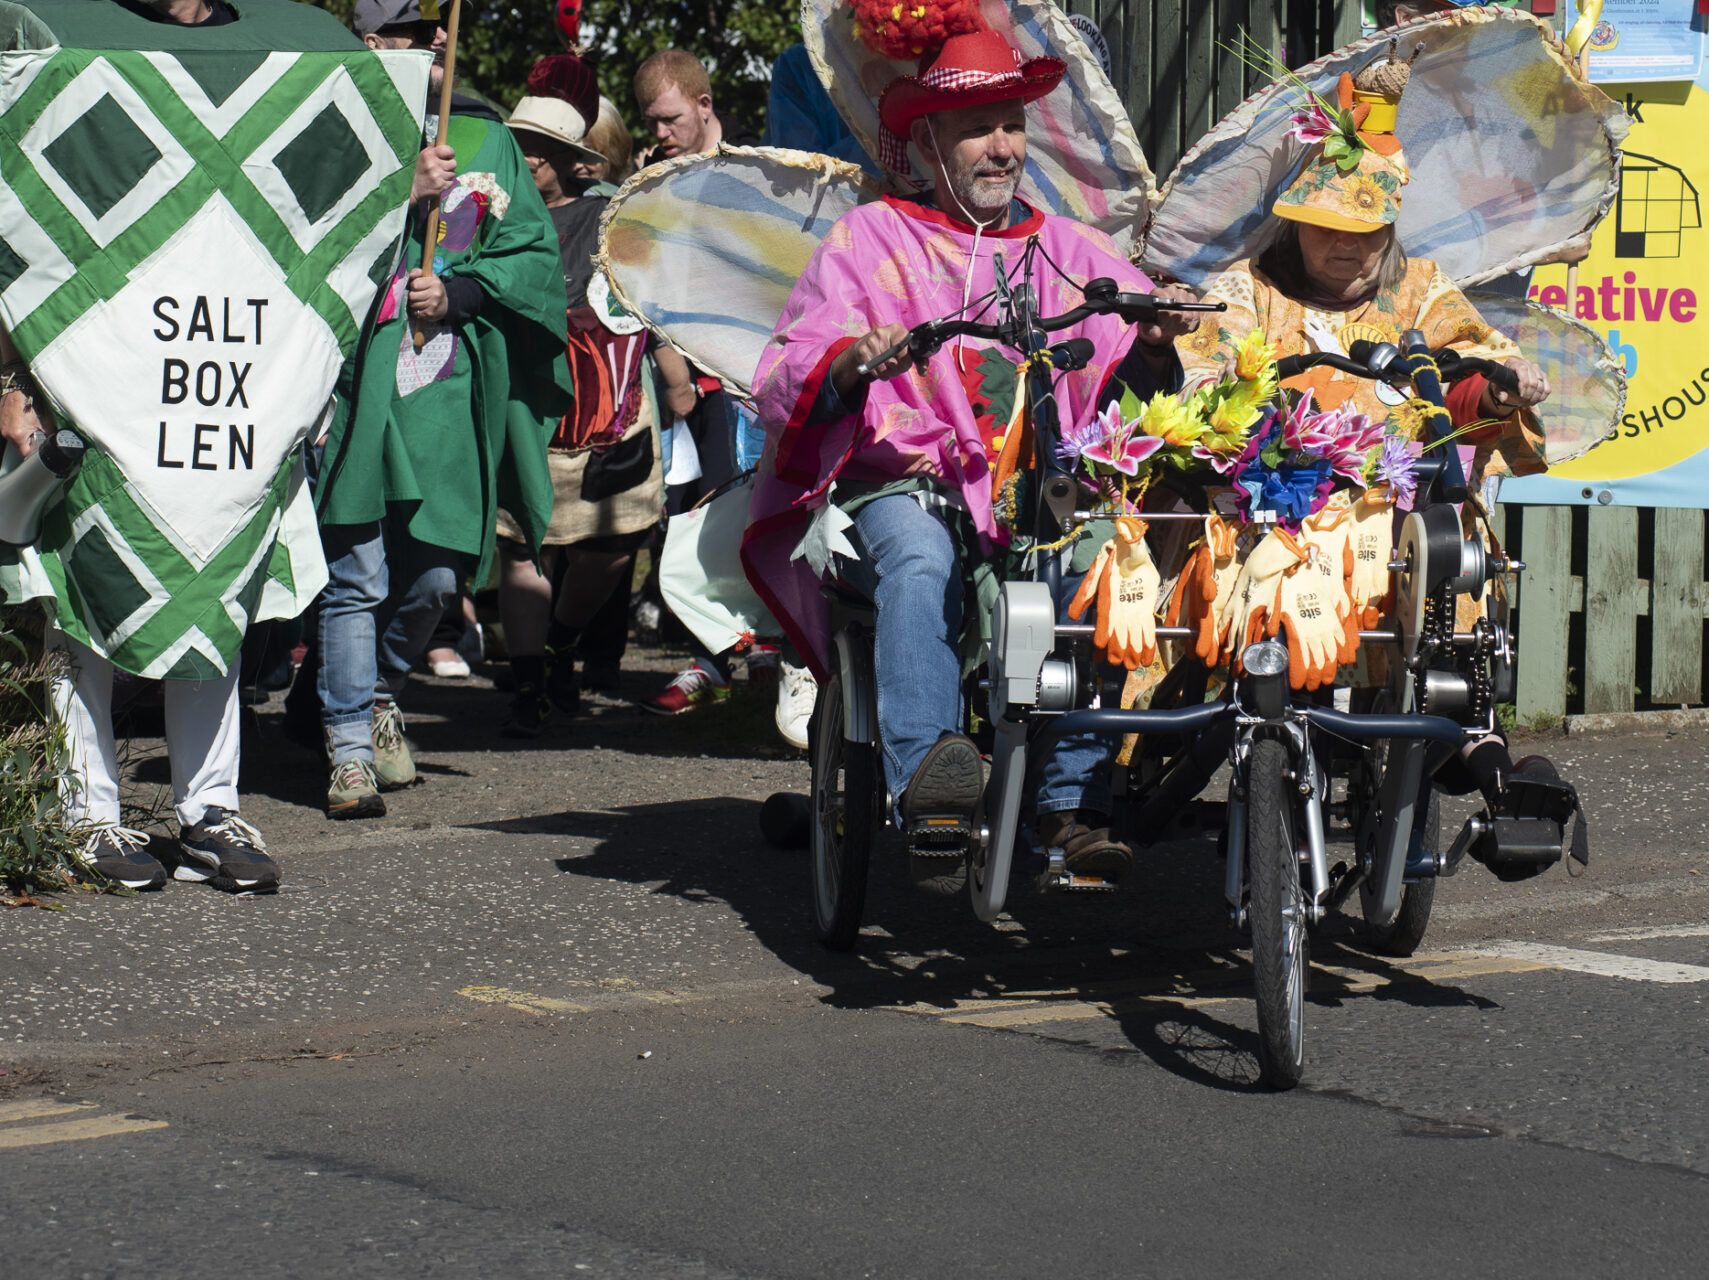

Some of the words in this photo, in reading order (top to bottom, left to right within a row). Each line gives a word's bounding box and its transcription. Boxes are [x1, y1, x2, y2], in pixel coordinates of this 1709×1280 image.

[1077, 18, 1108, 59] LOOKING
[152, 295, 270, 346] SALT
[161, 357, 253, 410] BOX
[157, 421, 254, 471] LEN
[1357, 550, 1377, 562] site
[1119, 592, 1144, 604] site
[1299, 607, 1322, 620] site
